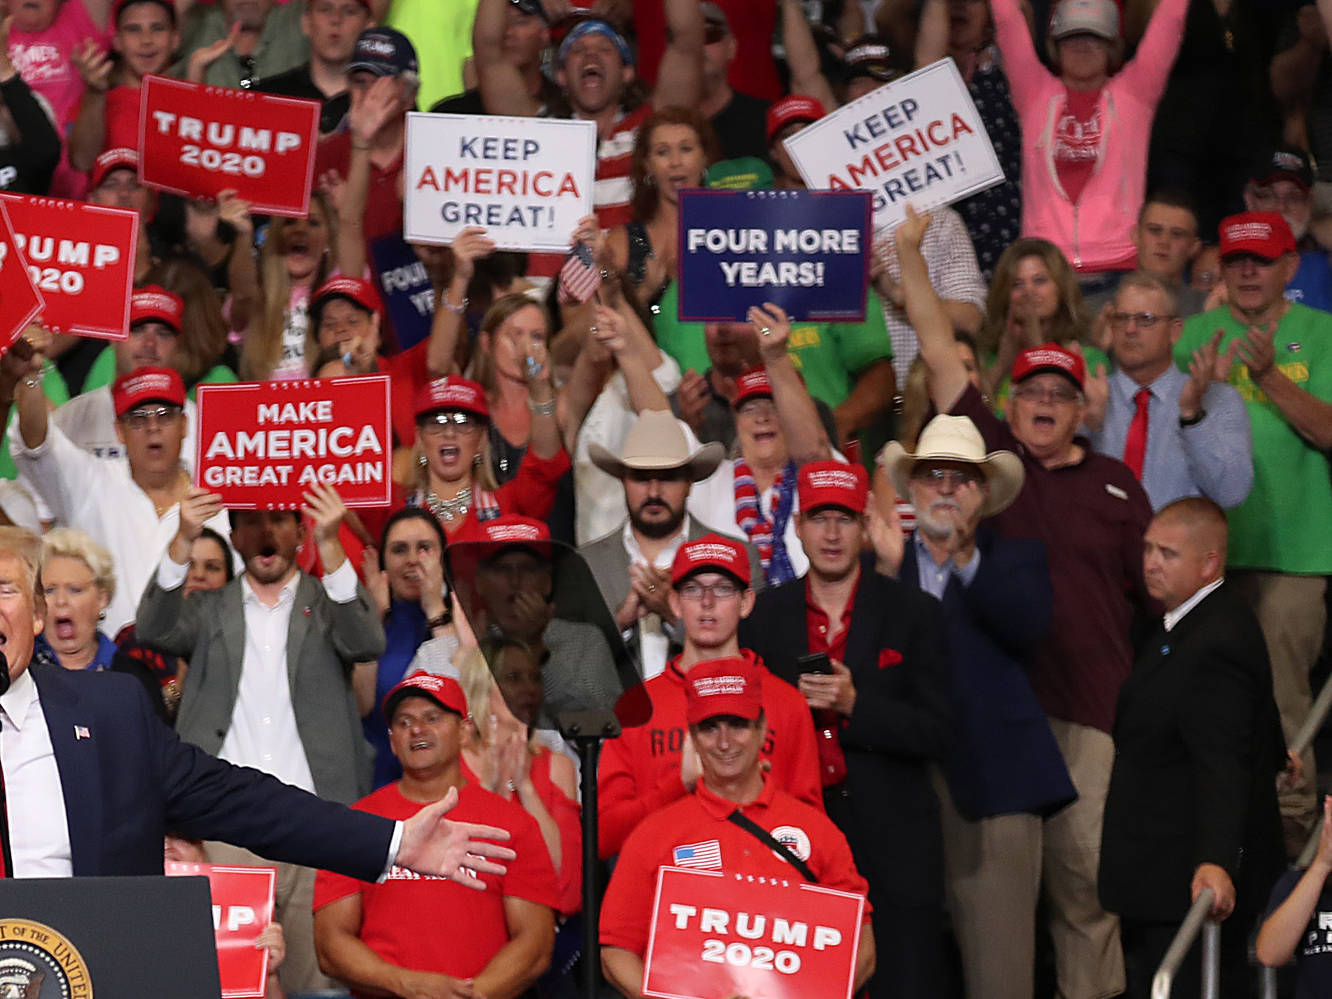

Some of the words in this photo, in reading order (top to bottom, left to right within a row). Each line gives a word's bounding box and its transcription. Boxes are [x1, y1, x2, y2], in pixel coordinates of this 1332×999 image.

[152, 110, 302, 154] TRUMP
[843, 98, 920, 150] KEEP
[180, 143, 267, 178] 2020
[459, 136, 540, 161] KEEP
[828, 112, 974, 191] AMERICA
[416, 165, 580, 199] AMERICA
[441, 201, 556, 229] GREAT!
[14, 233, 121, 269] UMP
[686, 228, 768, 254] FOUR
[774, 229, 860, 254] MORE
[28, 264, 85, 295] 020
[380, 262, 430, 295] FOU
[720, 262, 826, 287] YEARS!
[257, 400, 334, 425] MAKE
[204, 425, 383, 460] AMERICA
[204, 465, 294, 488] GREAT
[297, 461, 383, 487] AGAIN
[12, 926, 27, 937] OF
[30, 929, 50, 945] THE
[669, 903, 843, 951] TRUMP
[701, 939, 802, 974] 2020
